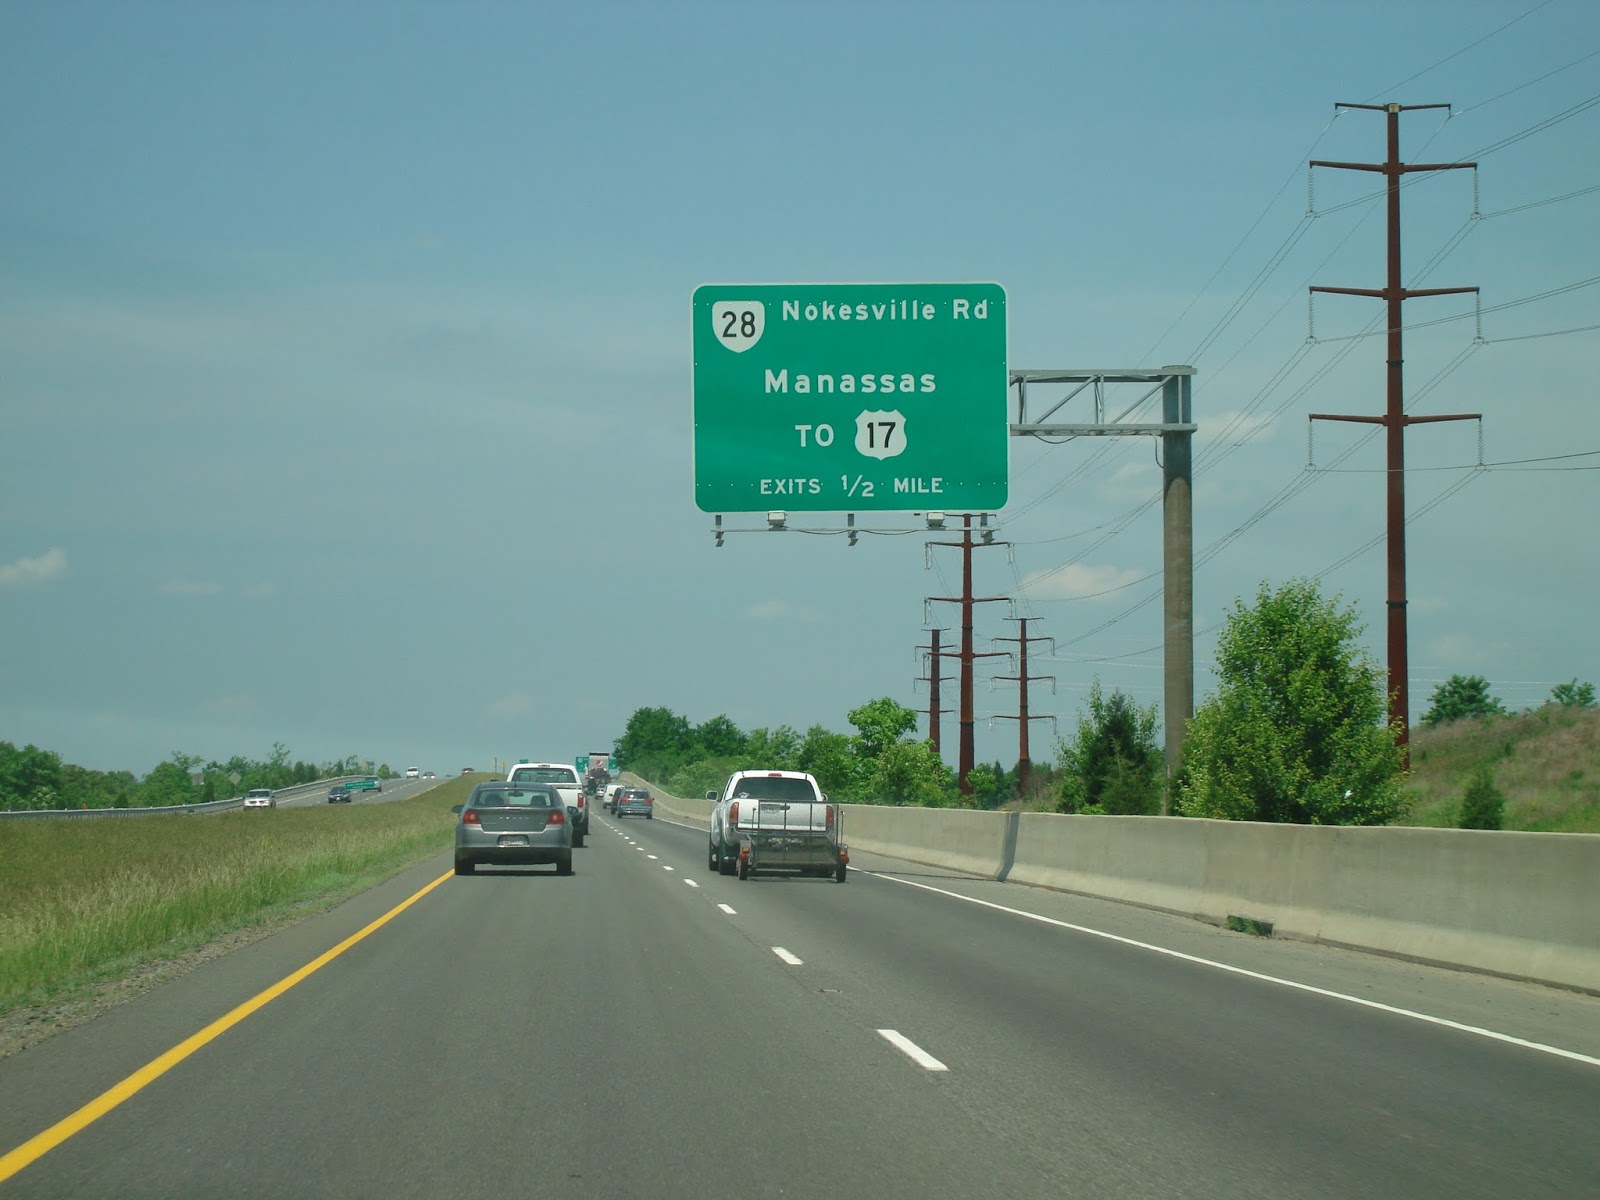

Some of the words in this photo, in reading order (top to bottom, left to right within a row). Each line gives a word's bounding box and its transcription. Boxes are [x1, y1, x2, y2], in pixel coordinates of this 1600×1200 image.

[782, 299, 936, 321] Nokesville
[953, 298, 988, 319] Rd
[721, 310, 756, 338] 28
[764, 369, 936, 394] Manassas
[795, 424, 834, 447] TO
[867, 421, 896, 448] 17
[760, 478, 821, 495] EXITS
[841, 474, 874, 497] 1/2
[894, 477, 943, 493] MILE
